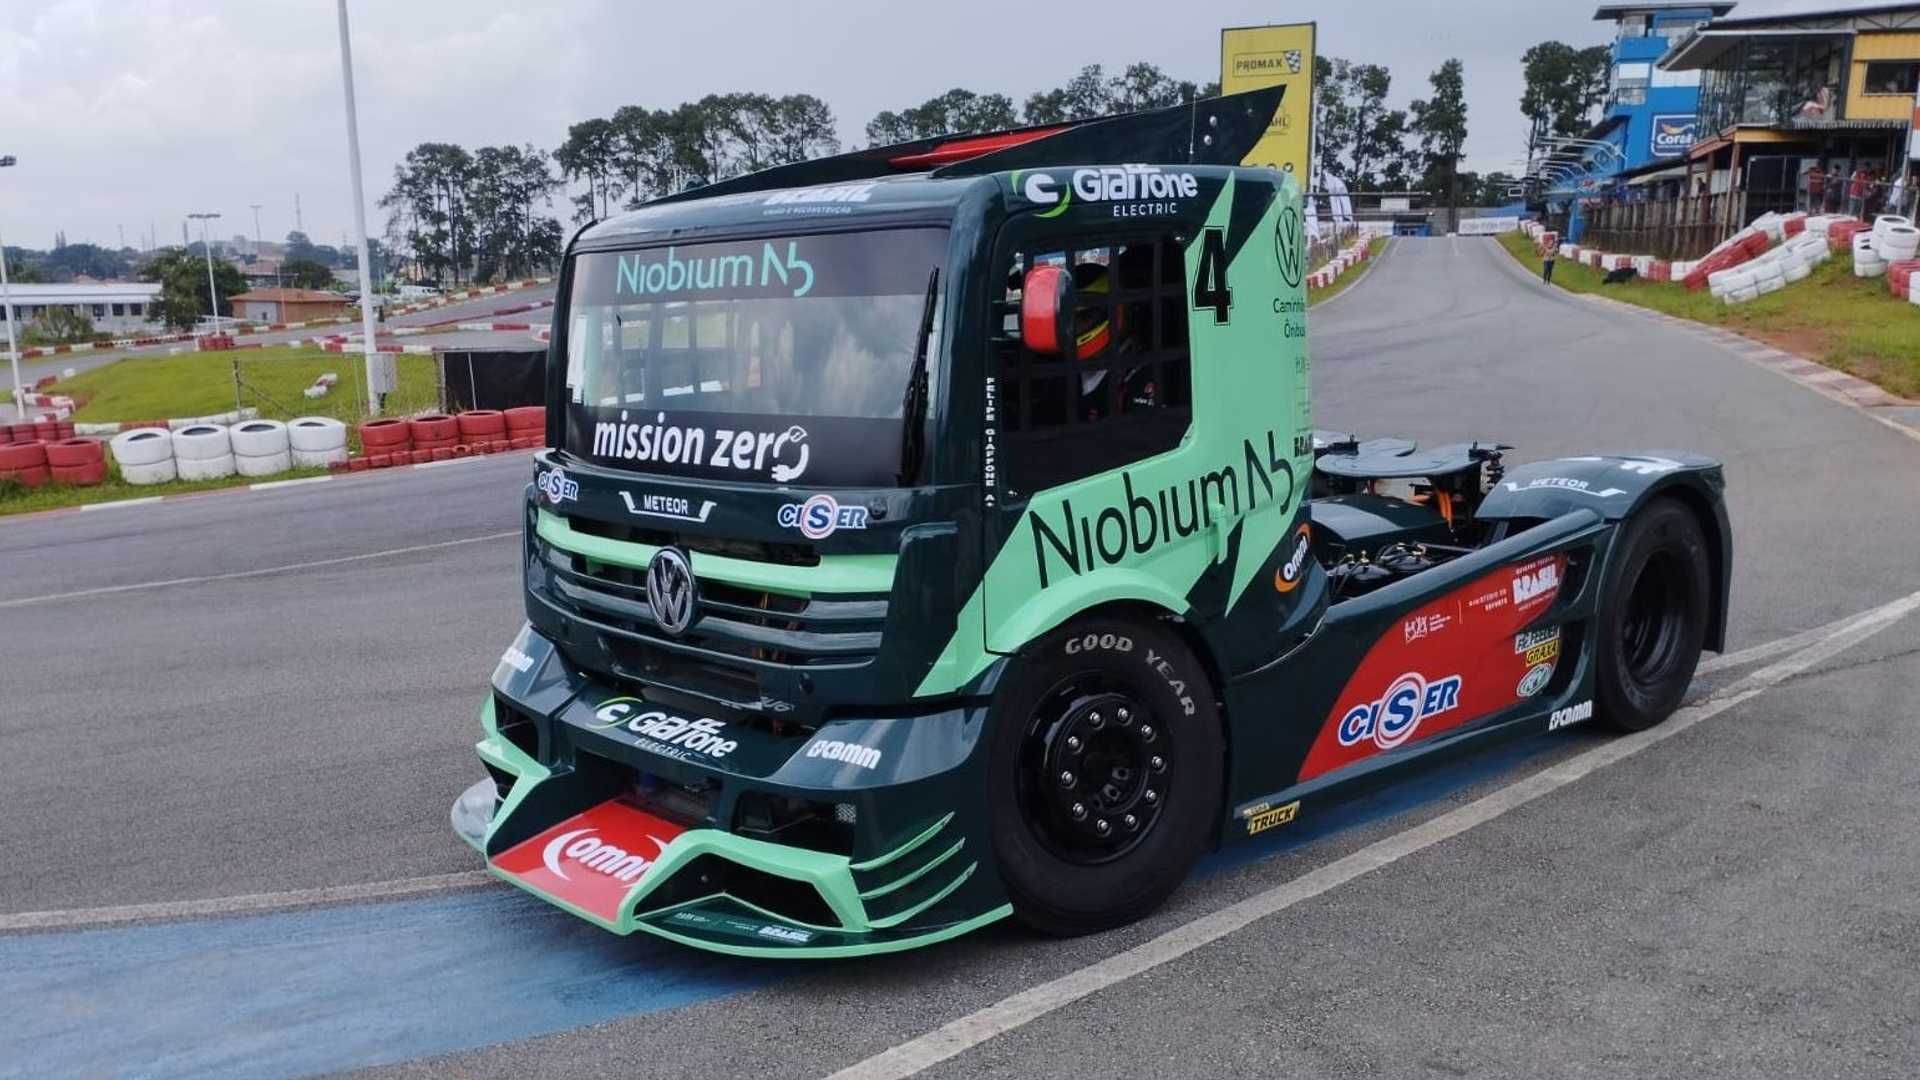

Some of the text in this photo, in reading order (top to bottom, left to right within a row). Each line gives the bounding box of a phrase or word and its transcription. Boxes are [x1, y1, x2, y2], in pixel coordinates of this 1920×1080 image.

[1236, 58, 1283, 71] PROMAX
[1113, 202, 1178, 217] ELECTRIC
[616, 246, 753, 295] Niobium
[1191, 225, 1234, 326] 4
[985, 377, 996, 421] FELIPE
[593, 410, 705, 465] mission
[985, 428, 996, 487] GIAFFONE
[538, 467, 579, 504] CISER
[643, 495, 688, 515] METEOR
[1531, 477, 1589, 490] METEOR
[777, 494, 868, 539] CISER
[1029, 472, 1240, 590] Niobium
[1065, 633, 1133, 655] GOOD
[1145, 649, 1196, 716] YEAR
[1338, 671, 1463, 750] CISER
[634, 737, 692, 761] ELECTRIC
[1253, 807, 1294, 833] TRUCK
